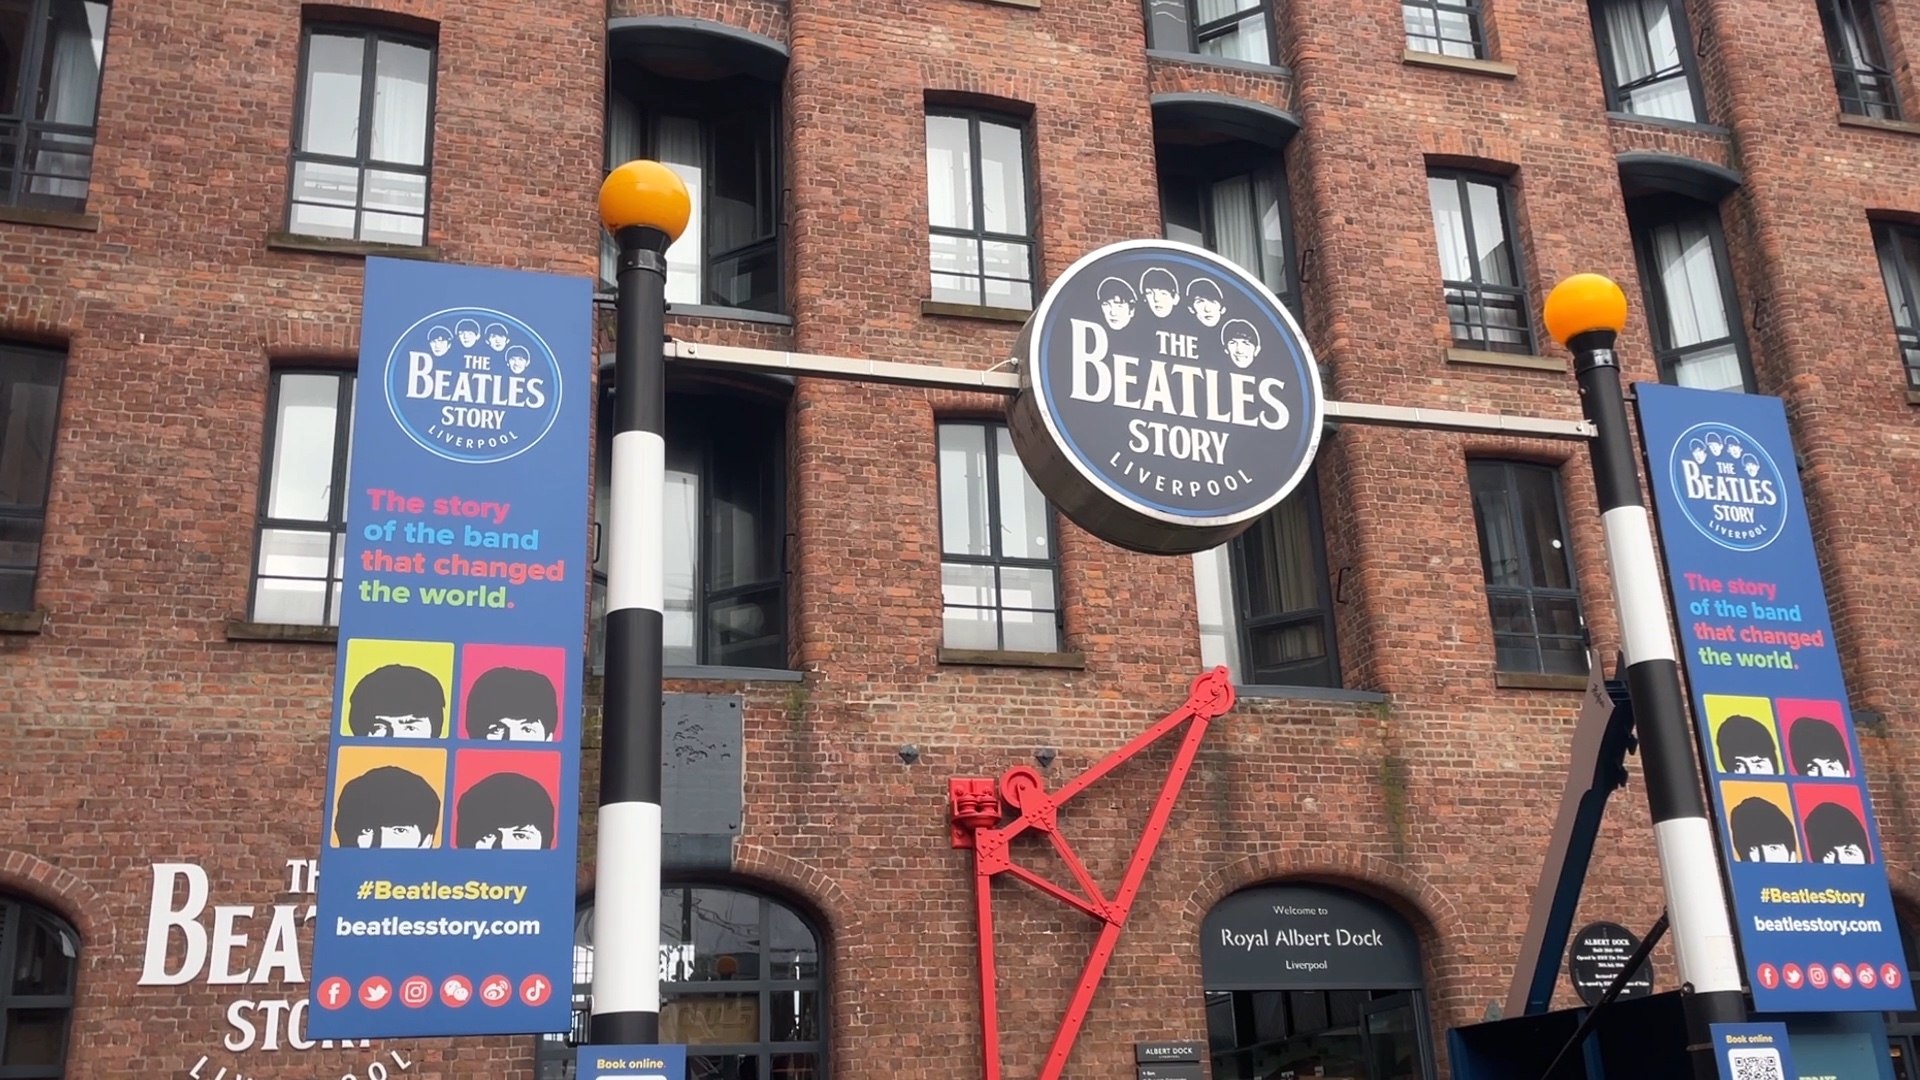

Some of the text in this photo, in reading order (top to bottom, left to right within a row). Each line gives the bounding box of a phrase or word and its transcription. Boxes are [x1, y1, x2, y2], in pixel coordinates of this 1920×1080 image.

[1155, 330, 1199, 360] THE
[464, 355, 491, 371] THE
[1070, 318, 1290, 430] BEATLES
[406, 351, 545, 409] BEATLES
[441, 406, 506, 429] STORY
[428, 425, 518, 449] LIVERPOOL
[1128, 419, 1229, 465] STORY
[1110, 451, 1252, 497] LIVERPOOL
[1716, 462, 1736, 475] THE
[1681, 459, 1777, 505] BEATLES
[367, 488, 510, 524] The story
[1713, 505, 1755, 523] STORY
[364, 520, 539, 550] of the band
[1709, 520, 1767, 540] LIVERPOOL
[361, 550, 565, 585] that changed
[359, 580, 515, 609] the world.
[1684, 573, 1776, 600] The story
[1690, 599, 1802, 622] of the band
[1694, 623, 1824, 649] that changed
[1698, 647, 1799, 670] the world.
[356, 880, 527, 904] #BeatlesStory
[1760, 888, 1866, 907] #BeatlesStory
[1272, 905, 1328, 916] Welcome to
[336, 916, 540, 940] beatlesstory.com
[1754, 916, 1882, 935] beatlesstory.com
[1221, 928, 1383, 951] Royal Albert Dock
[1286, 960, 1328, 971] Liverpool
[1726, 1034, 1747, 1044] Book
[1145, 1047, 1193, 1055] ALBERT DOCK
[596, 1058, 626, 1069] Book
